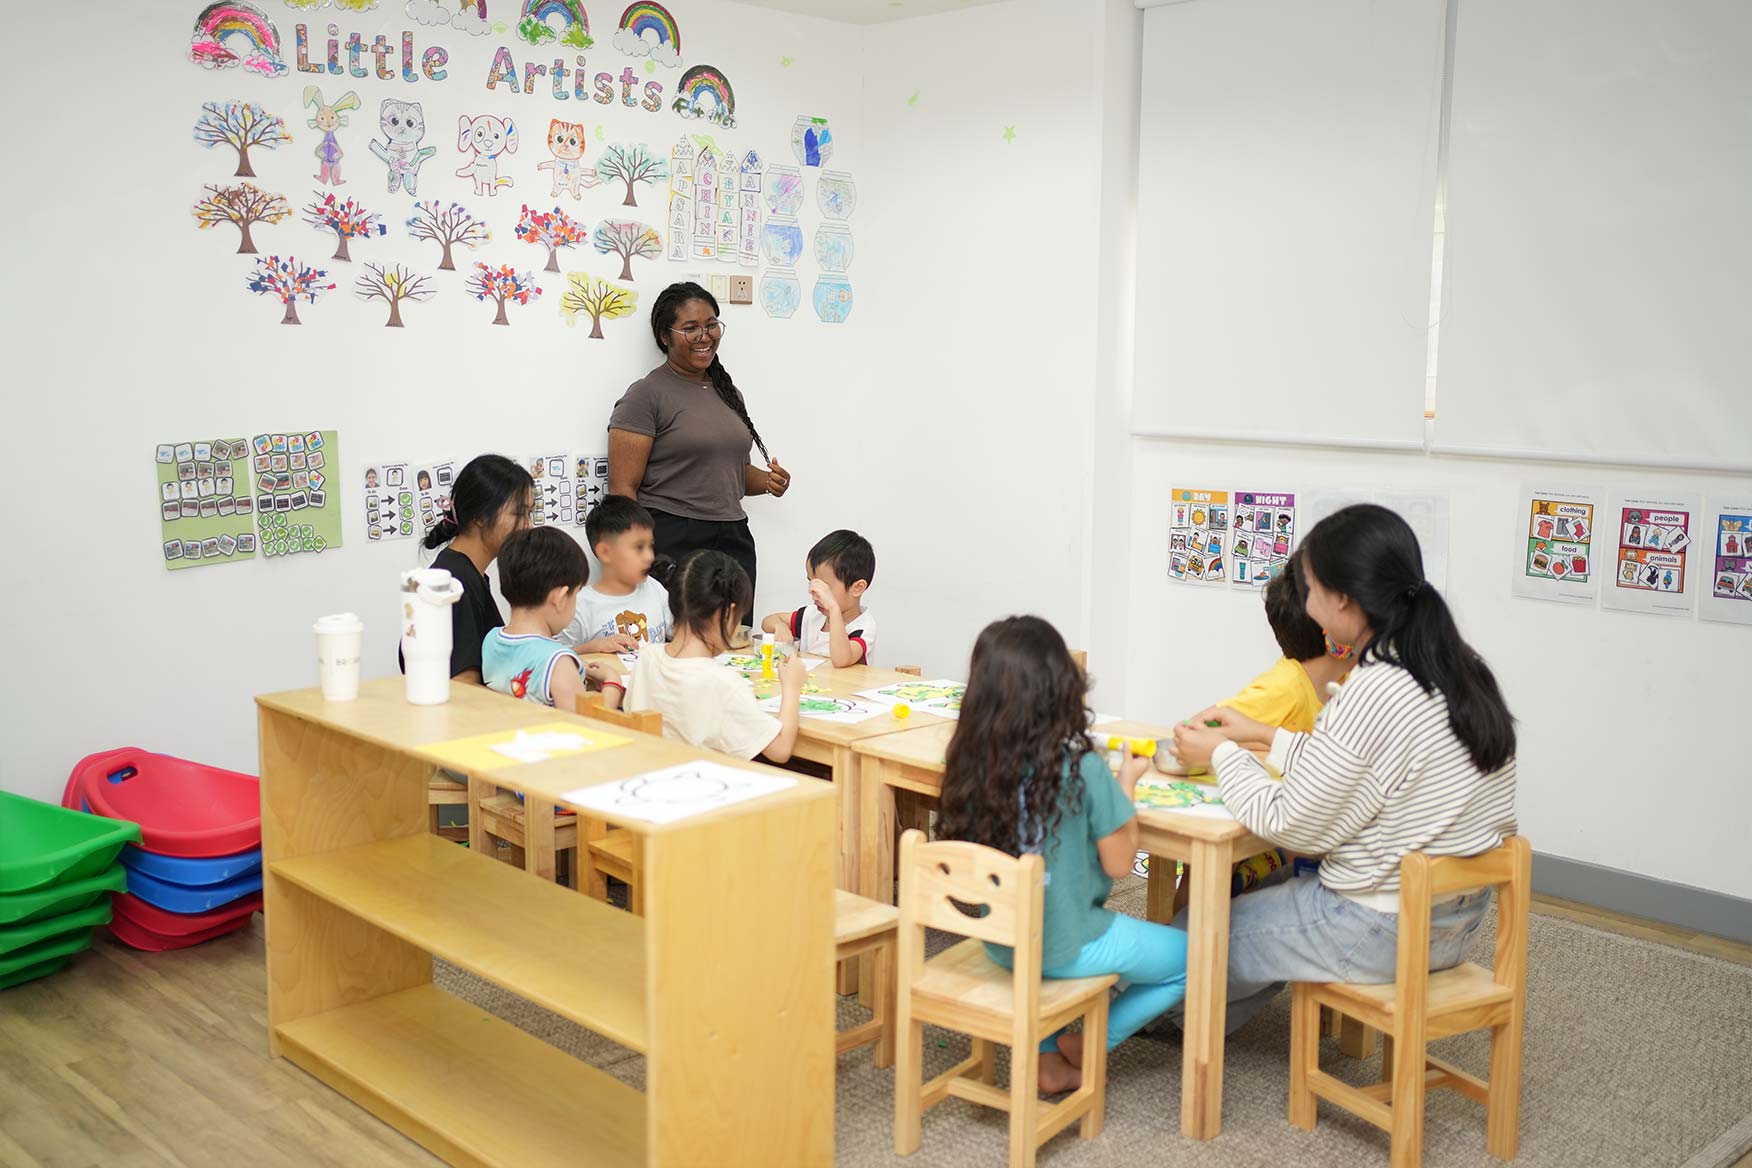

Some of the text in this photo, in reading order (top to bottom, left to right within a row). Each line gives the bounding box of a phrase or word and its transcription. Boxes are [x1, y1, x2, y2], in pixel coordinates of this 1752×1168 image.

[296, 23, 663, 113] Little Artists
[672, 161, 687, 258] APSARA
[700, 173, 712, 235] CHIN
[722, 177, 734, 241] RYAN
[744, 175, 757, 251] ANNIE
[1193, 492, 1211, 501] DAY
[1256, 495, 1287, 505] NIGHT
[1560, 507, 1586, 515] clothing
[1654, 515, 1680, 523] people
[1650, 555, 1677, 563] animals
